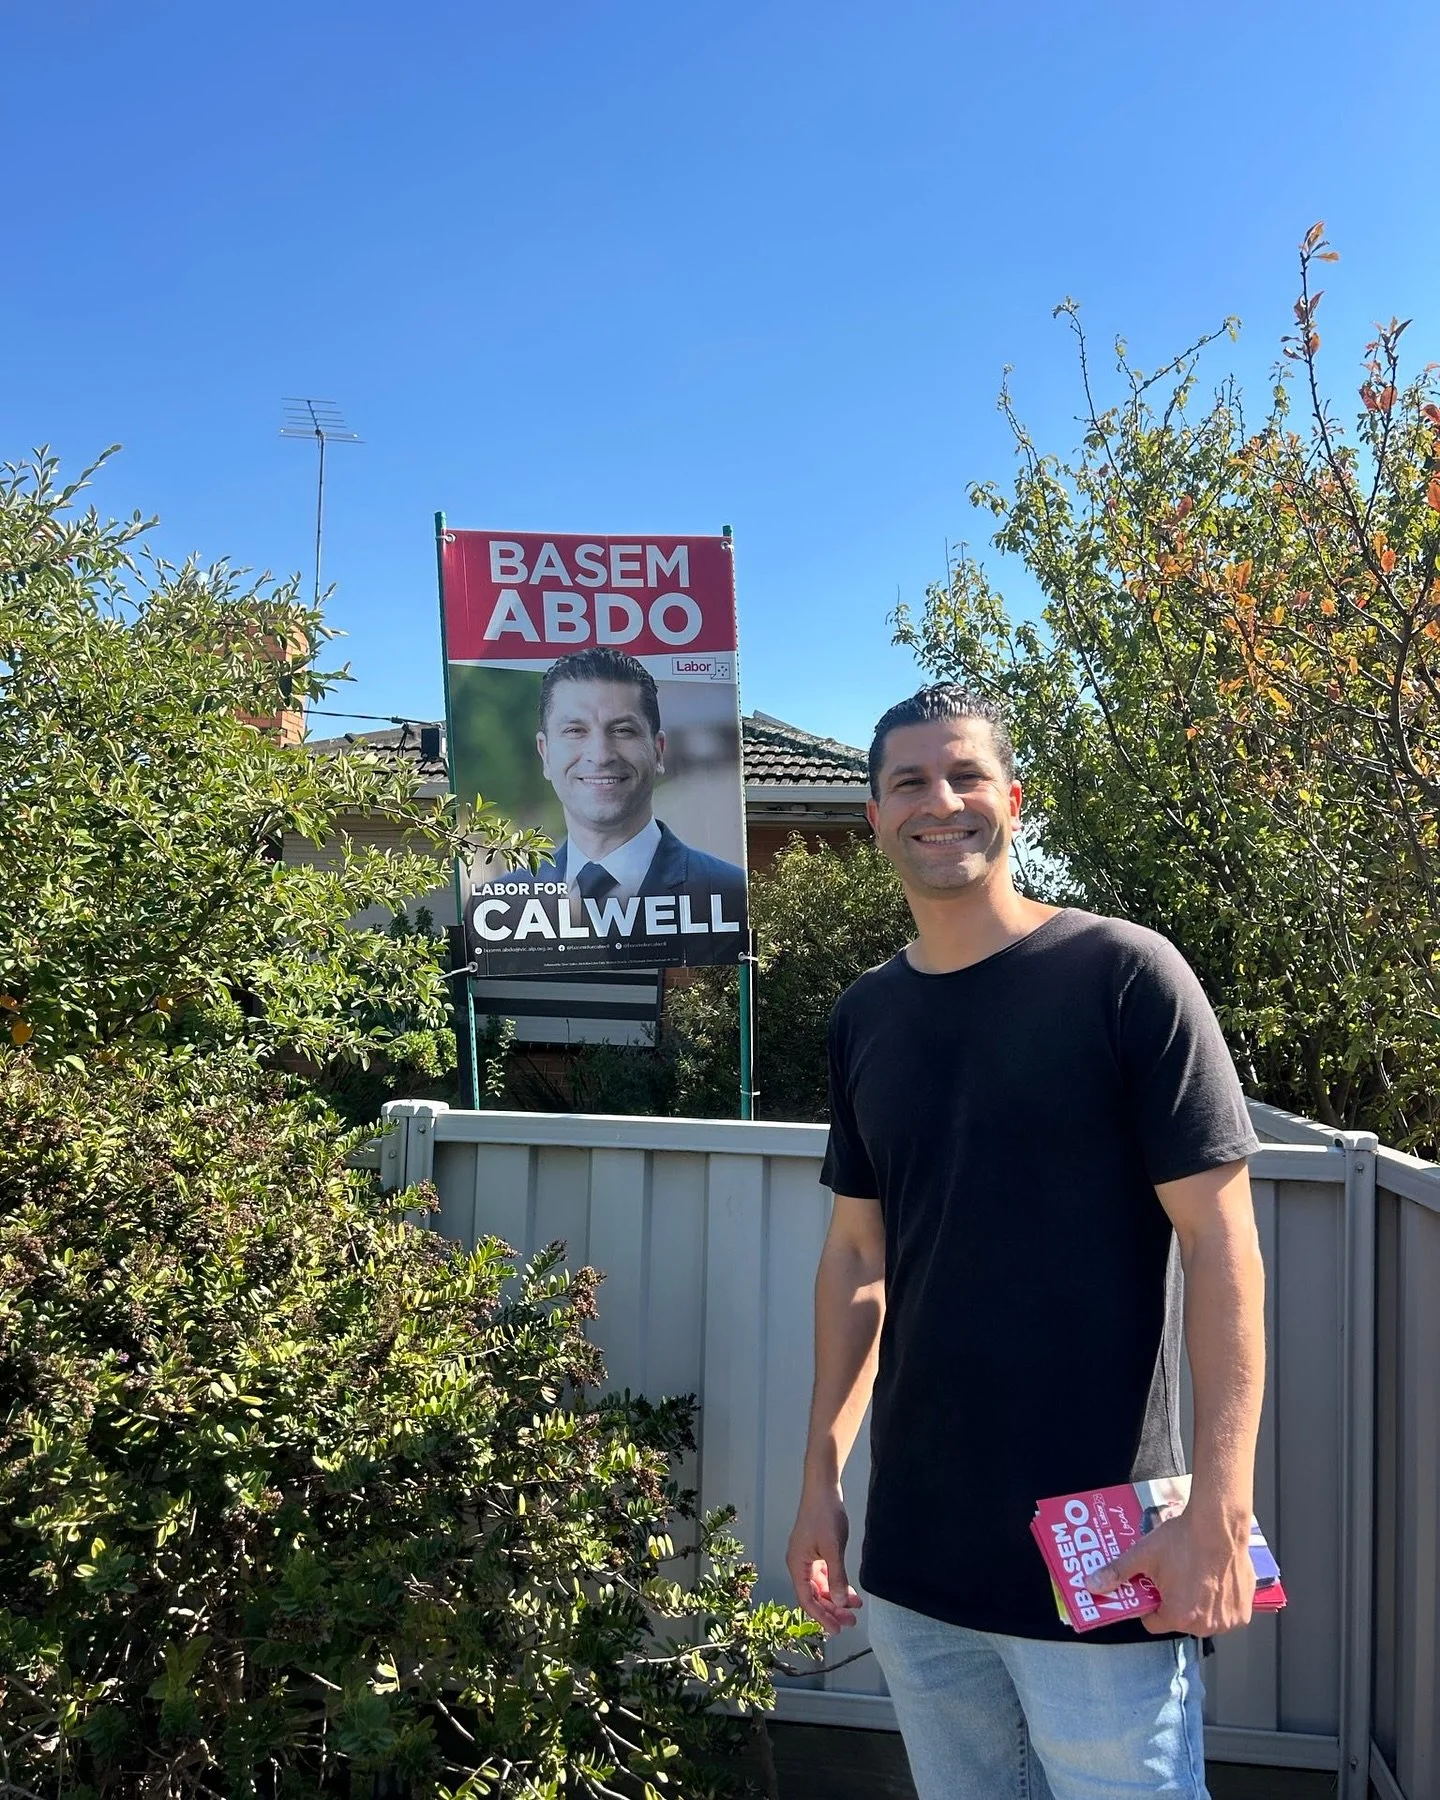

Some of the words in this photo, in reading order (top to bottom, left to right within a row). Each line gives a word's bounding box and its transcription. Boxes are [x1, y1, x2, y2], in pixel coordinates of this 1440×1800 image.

[489, 541, 689, 588] BASEM
[483, 589, 703, 646] ABDO
[676, 660, 712, 672] Labor
[471, 883, 530, 896] LABOR
[534, 882, 568, 895] FOR
[473, 894, 740, 941] CALWELL
